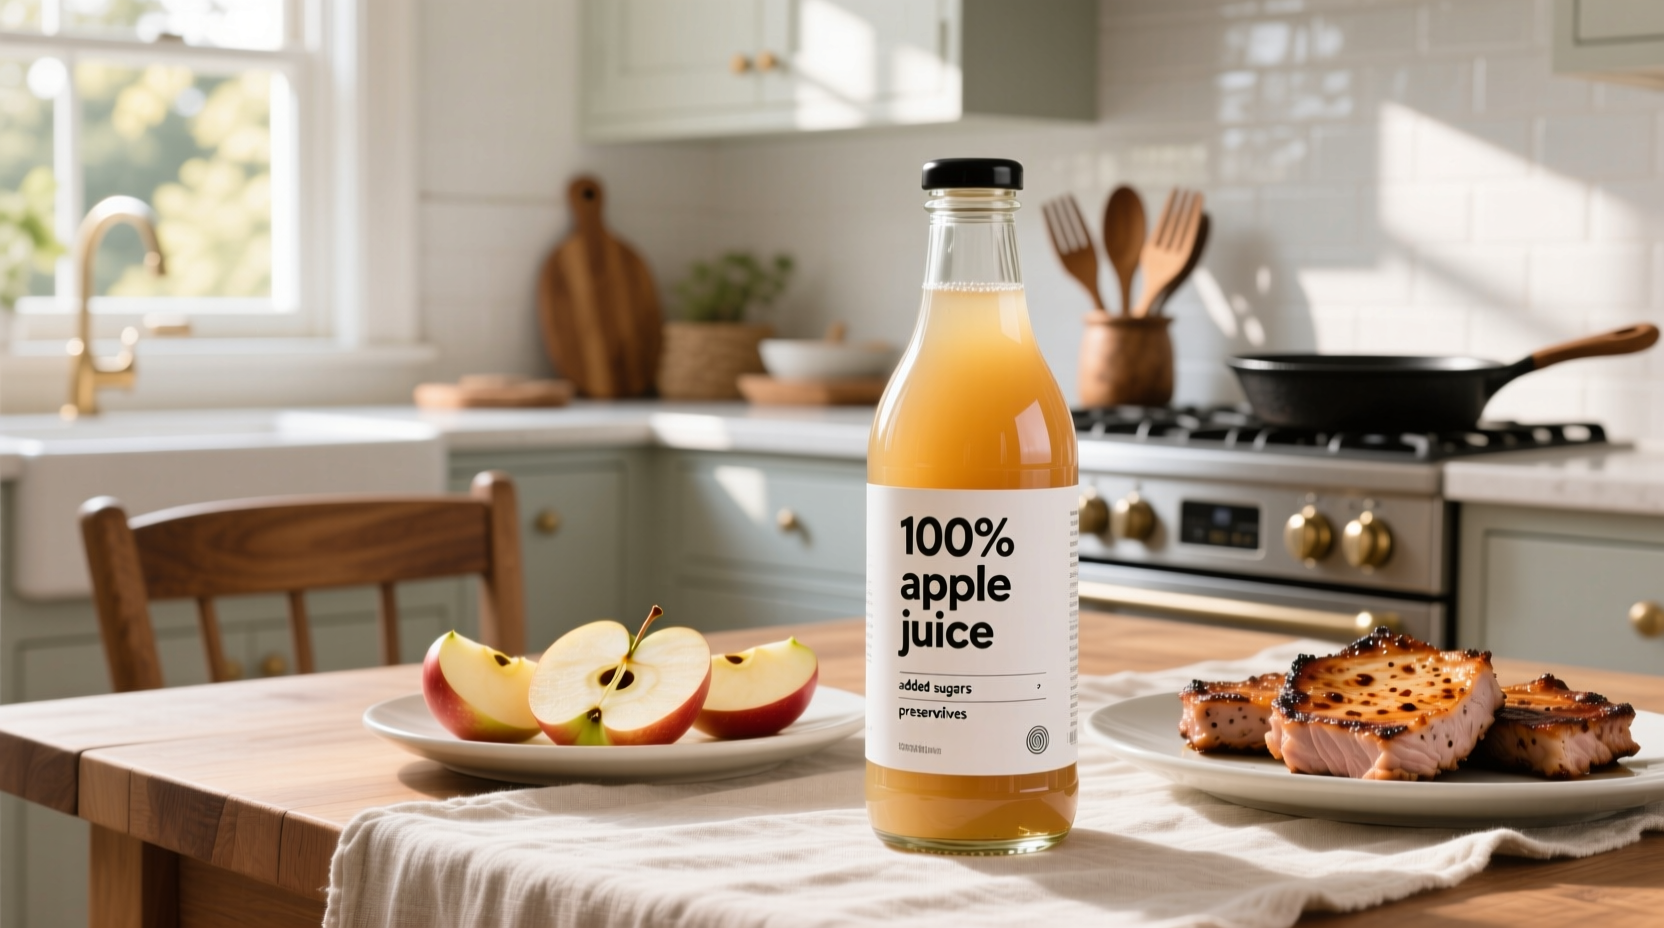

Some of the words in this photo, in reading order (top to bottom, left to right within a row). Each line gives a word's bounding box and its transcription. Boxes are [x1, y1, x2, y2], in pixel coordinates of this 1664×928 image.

[900, 515, 1015, 558] 100%
[900, 564, 1012, 611] apple
[897, 608, 994, 658] juice
[898, 678, 931, 693] added
[933, 684, 973, 698] sugars
